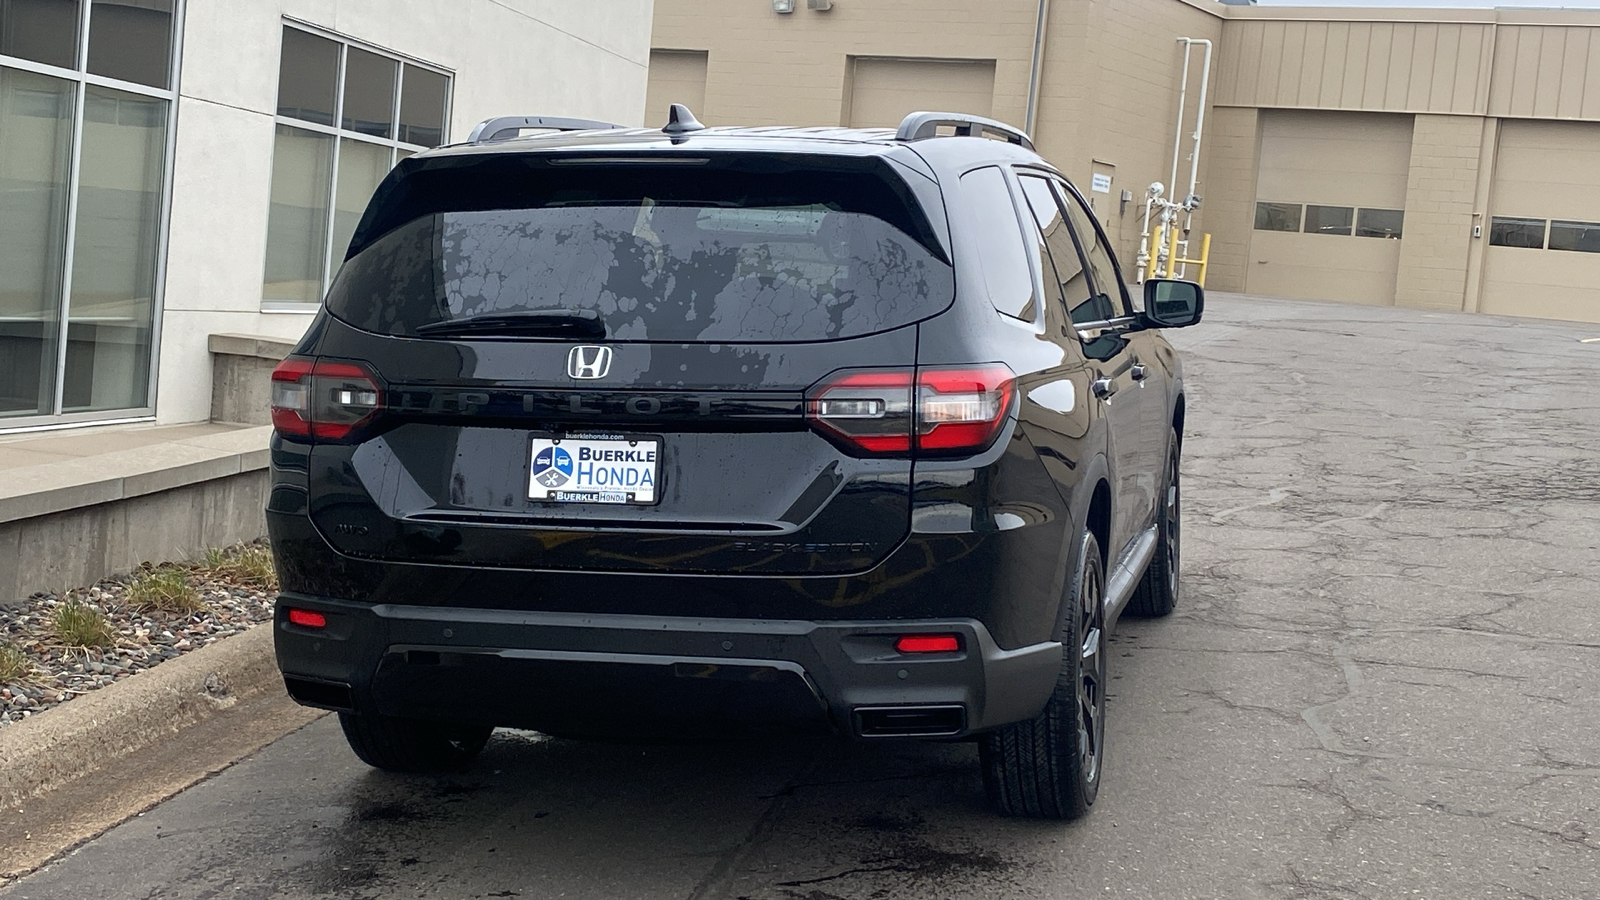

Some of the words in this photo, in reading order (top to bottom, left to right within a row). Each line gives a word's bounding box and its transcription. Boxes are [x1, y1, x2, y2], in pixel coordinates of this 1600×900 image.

[458, 392, 722, 415] PILOT
[565, 432, 624, 440] buerklehonda.com
[579, 447, 655, 462] BUERKLE
[577, 462, 654, 486] HONDA
[557, 492, 599, 501] BUERKLE
[600, 493, 625, 501] HONDA
[733, 541, 801, 552] BLACK
[804, 541, 878, 553] EDITION
